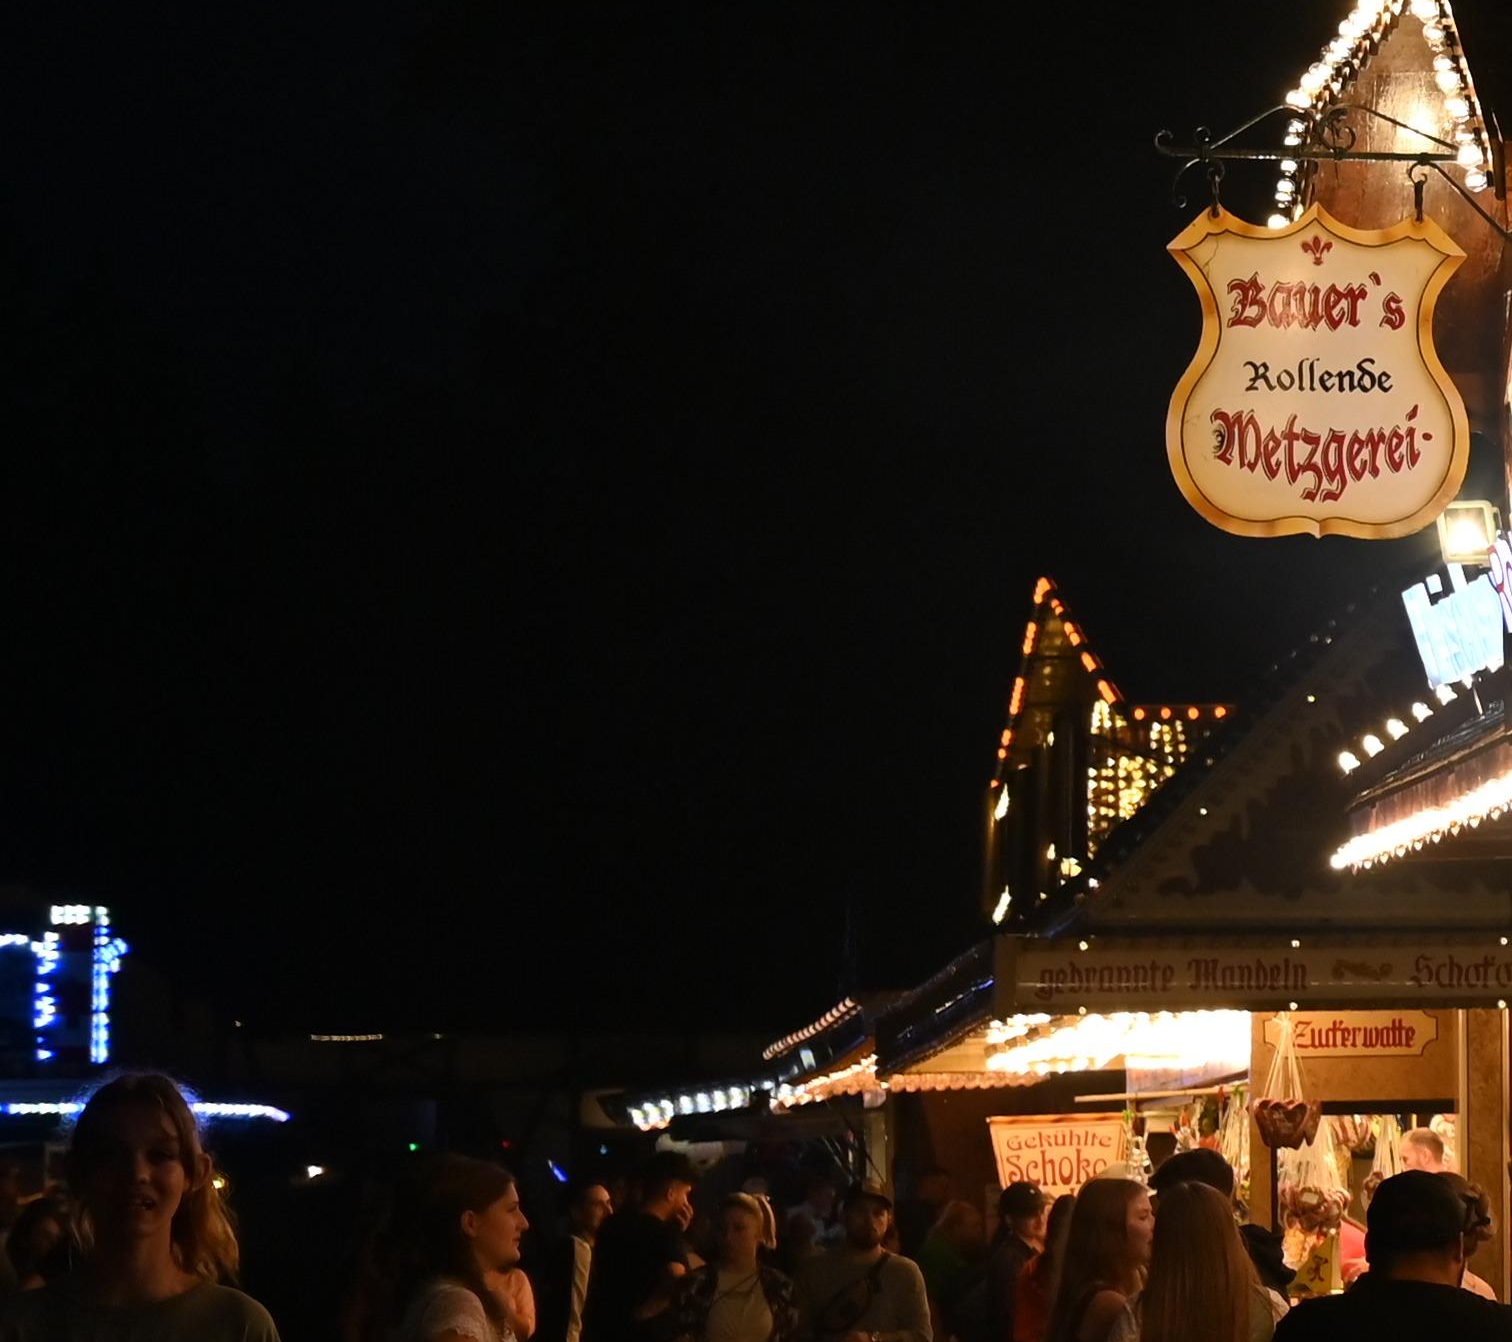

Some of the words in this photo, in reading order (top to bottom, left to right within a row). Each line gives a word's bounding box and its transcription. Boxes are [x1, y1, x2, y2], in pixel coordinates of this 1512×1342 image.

[1244, 358, 1393, 392] Rollende
[1035, 960, 1175, 1001] gebrannte
[1188, 958, 1308, 992] Mandeln
[1294, 1018, 1416, 1049] Zuckerwatte
[1006, 1129, 1112, 1151] Gekühlte
[1006, 1148, 1107, 1186] Schoko
